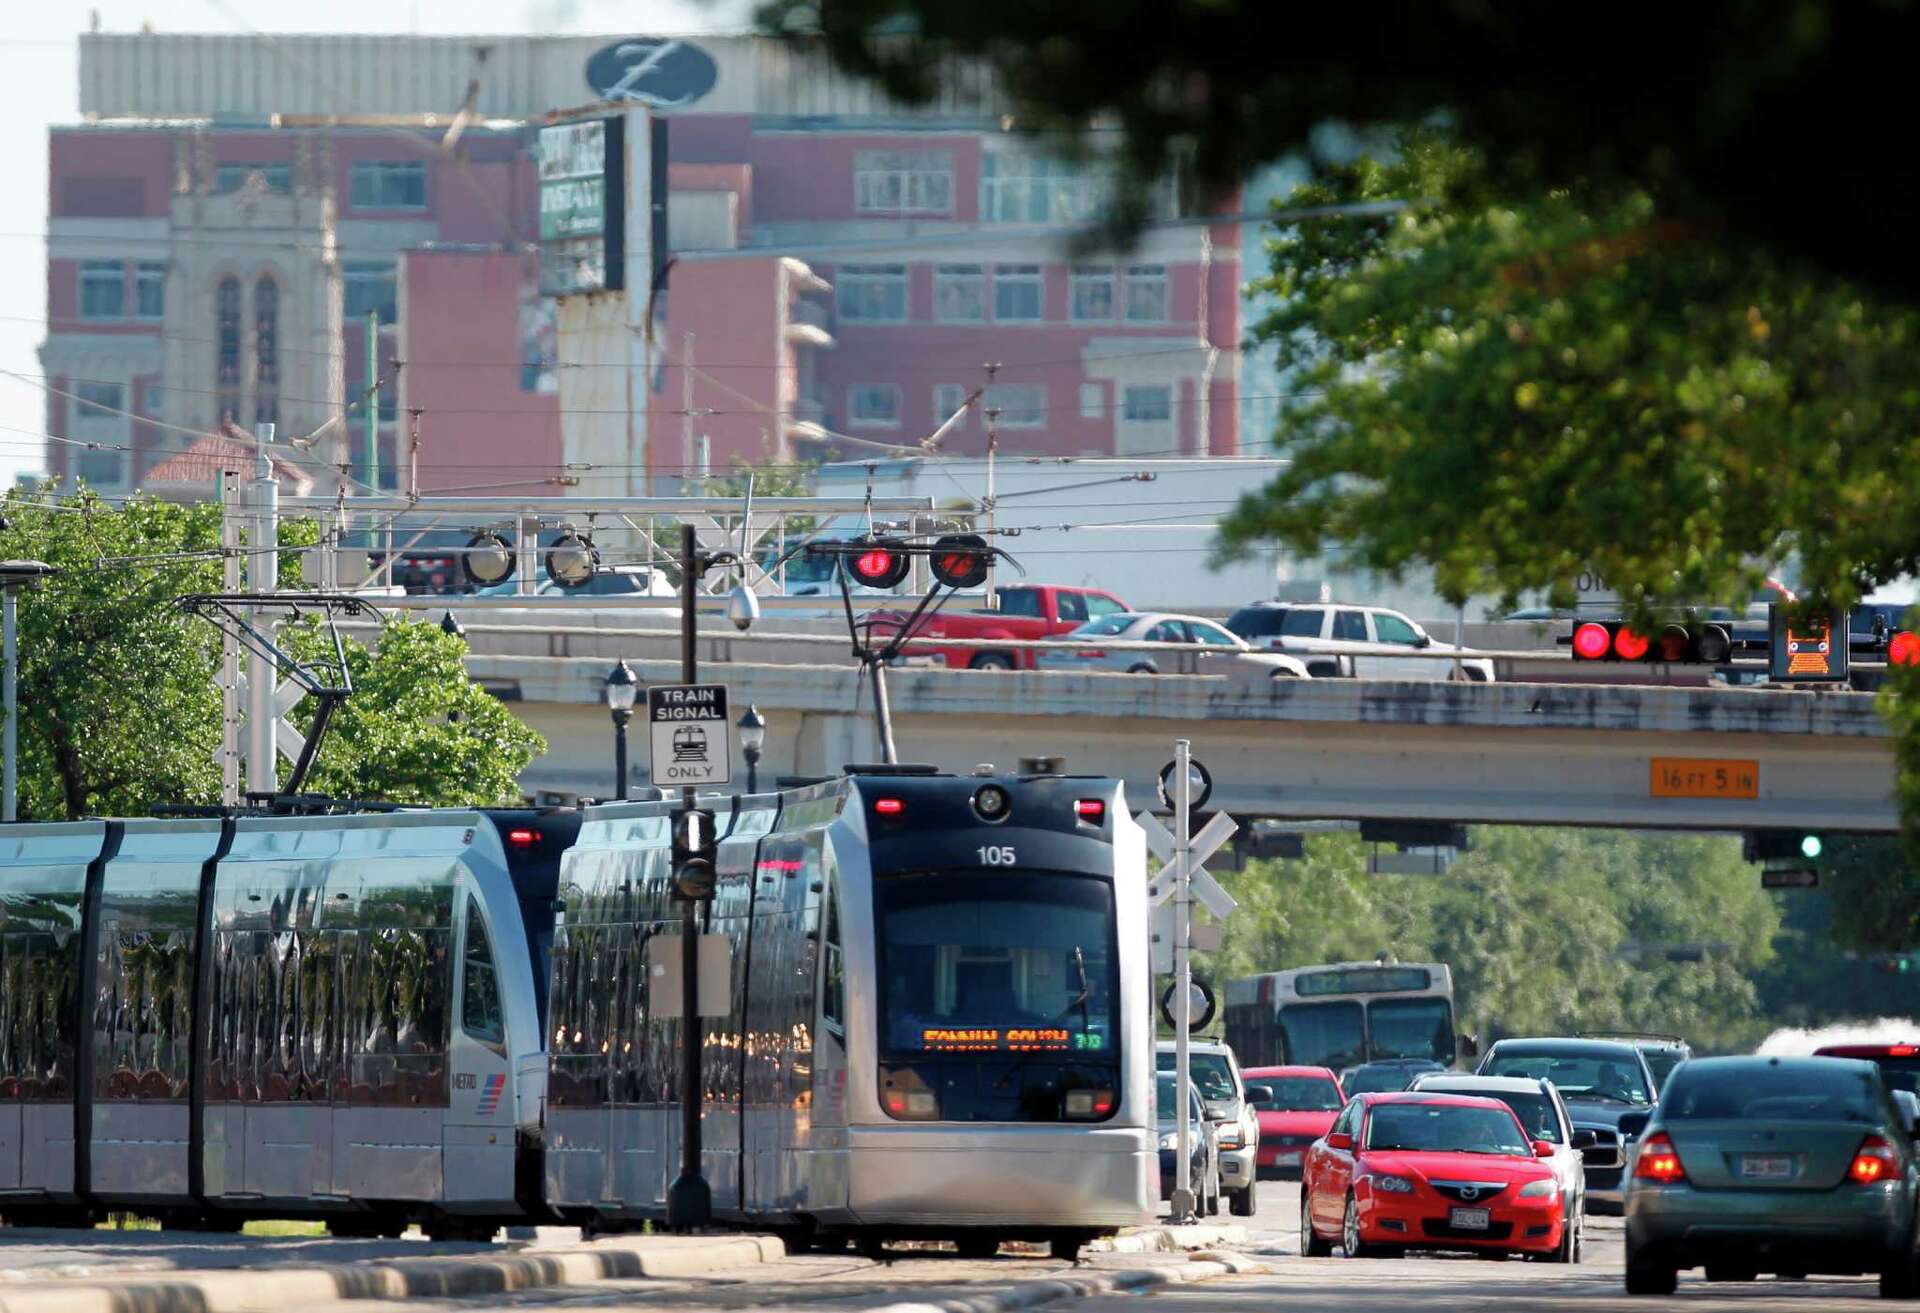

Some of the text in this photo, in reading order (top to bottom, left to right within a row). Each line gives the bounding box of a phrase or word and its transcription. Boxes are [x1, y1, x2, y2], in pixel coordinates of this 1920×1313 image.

[662, 689, 715, 703] TRAIN
[656, 706, 721, 720] SIGNAL
[667, 766, 713, 778] ONLY
[1663, 767, 1752, 791] 16 FT 5 IN
[976, 846, 1016, 865] 105
[452, 1072, 477, 1090] METRO
